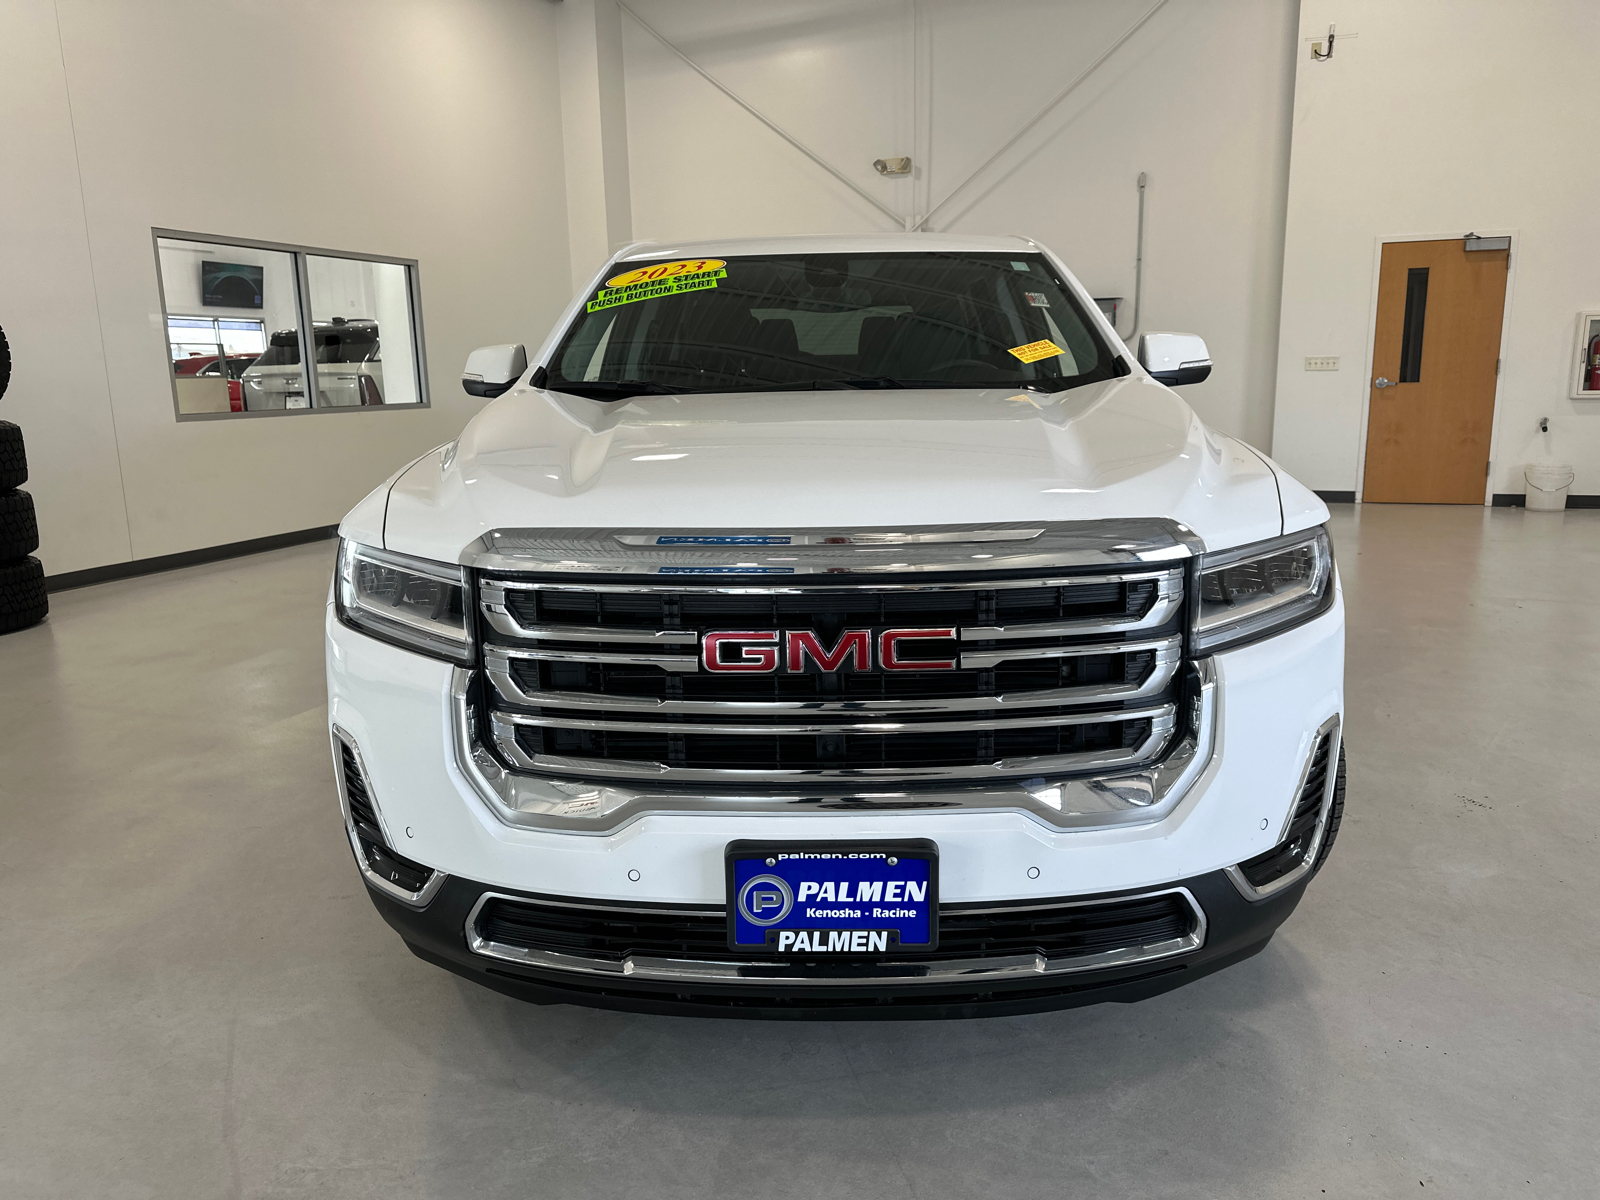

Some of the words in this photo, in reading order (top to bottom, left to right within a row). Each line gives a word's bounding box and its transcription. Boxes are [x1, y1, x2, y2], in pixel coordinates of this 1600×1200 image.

[603, 278, 669, 297] REMOTE
[673, 269, 721, 283] START
[628, 261, 707, 284] 2023
[590, 296, 624, 310] PUSH
[625, 286, 673, 301] BUTTON
[675, 279, 714, 291] START
[1025, 340, 1050, 349] VEHICLE
[701, 627, 957, 674] GMC
[777, 852, 887, 861] palmen.com
[797, 880, 928, 902] PALMEN
[806, 908, 861, 918] Kenosha
[872, 908, 917, 918] Racine
[778, 931, 888, 952] PALMEN
